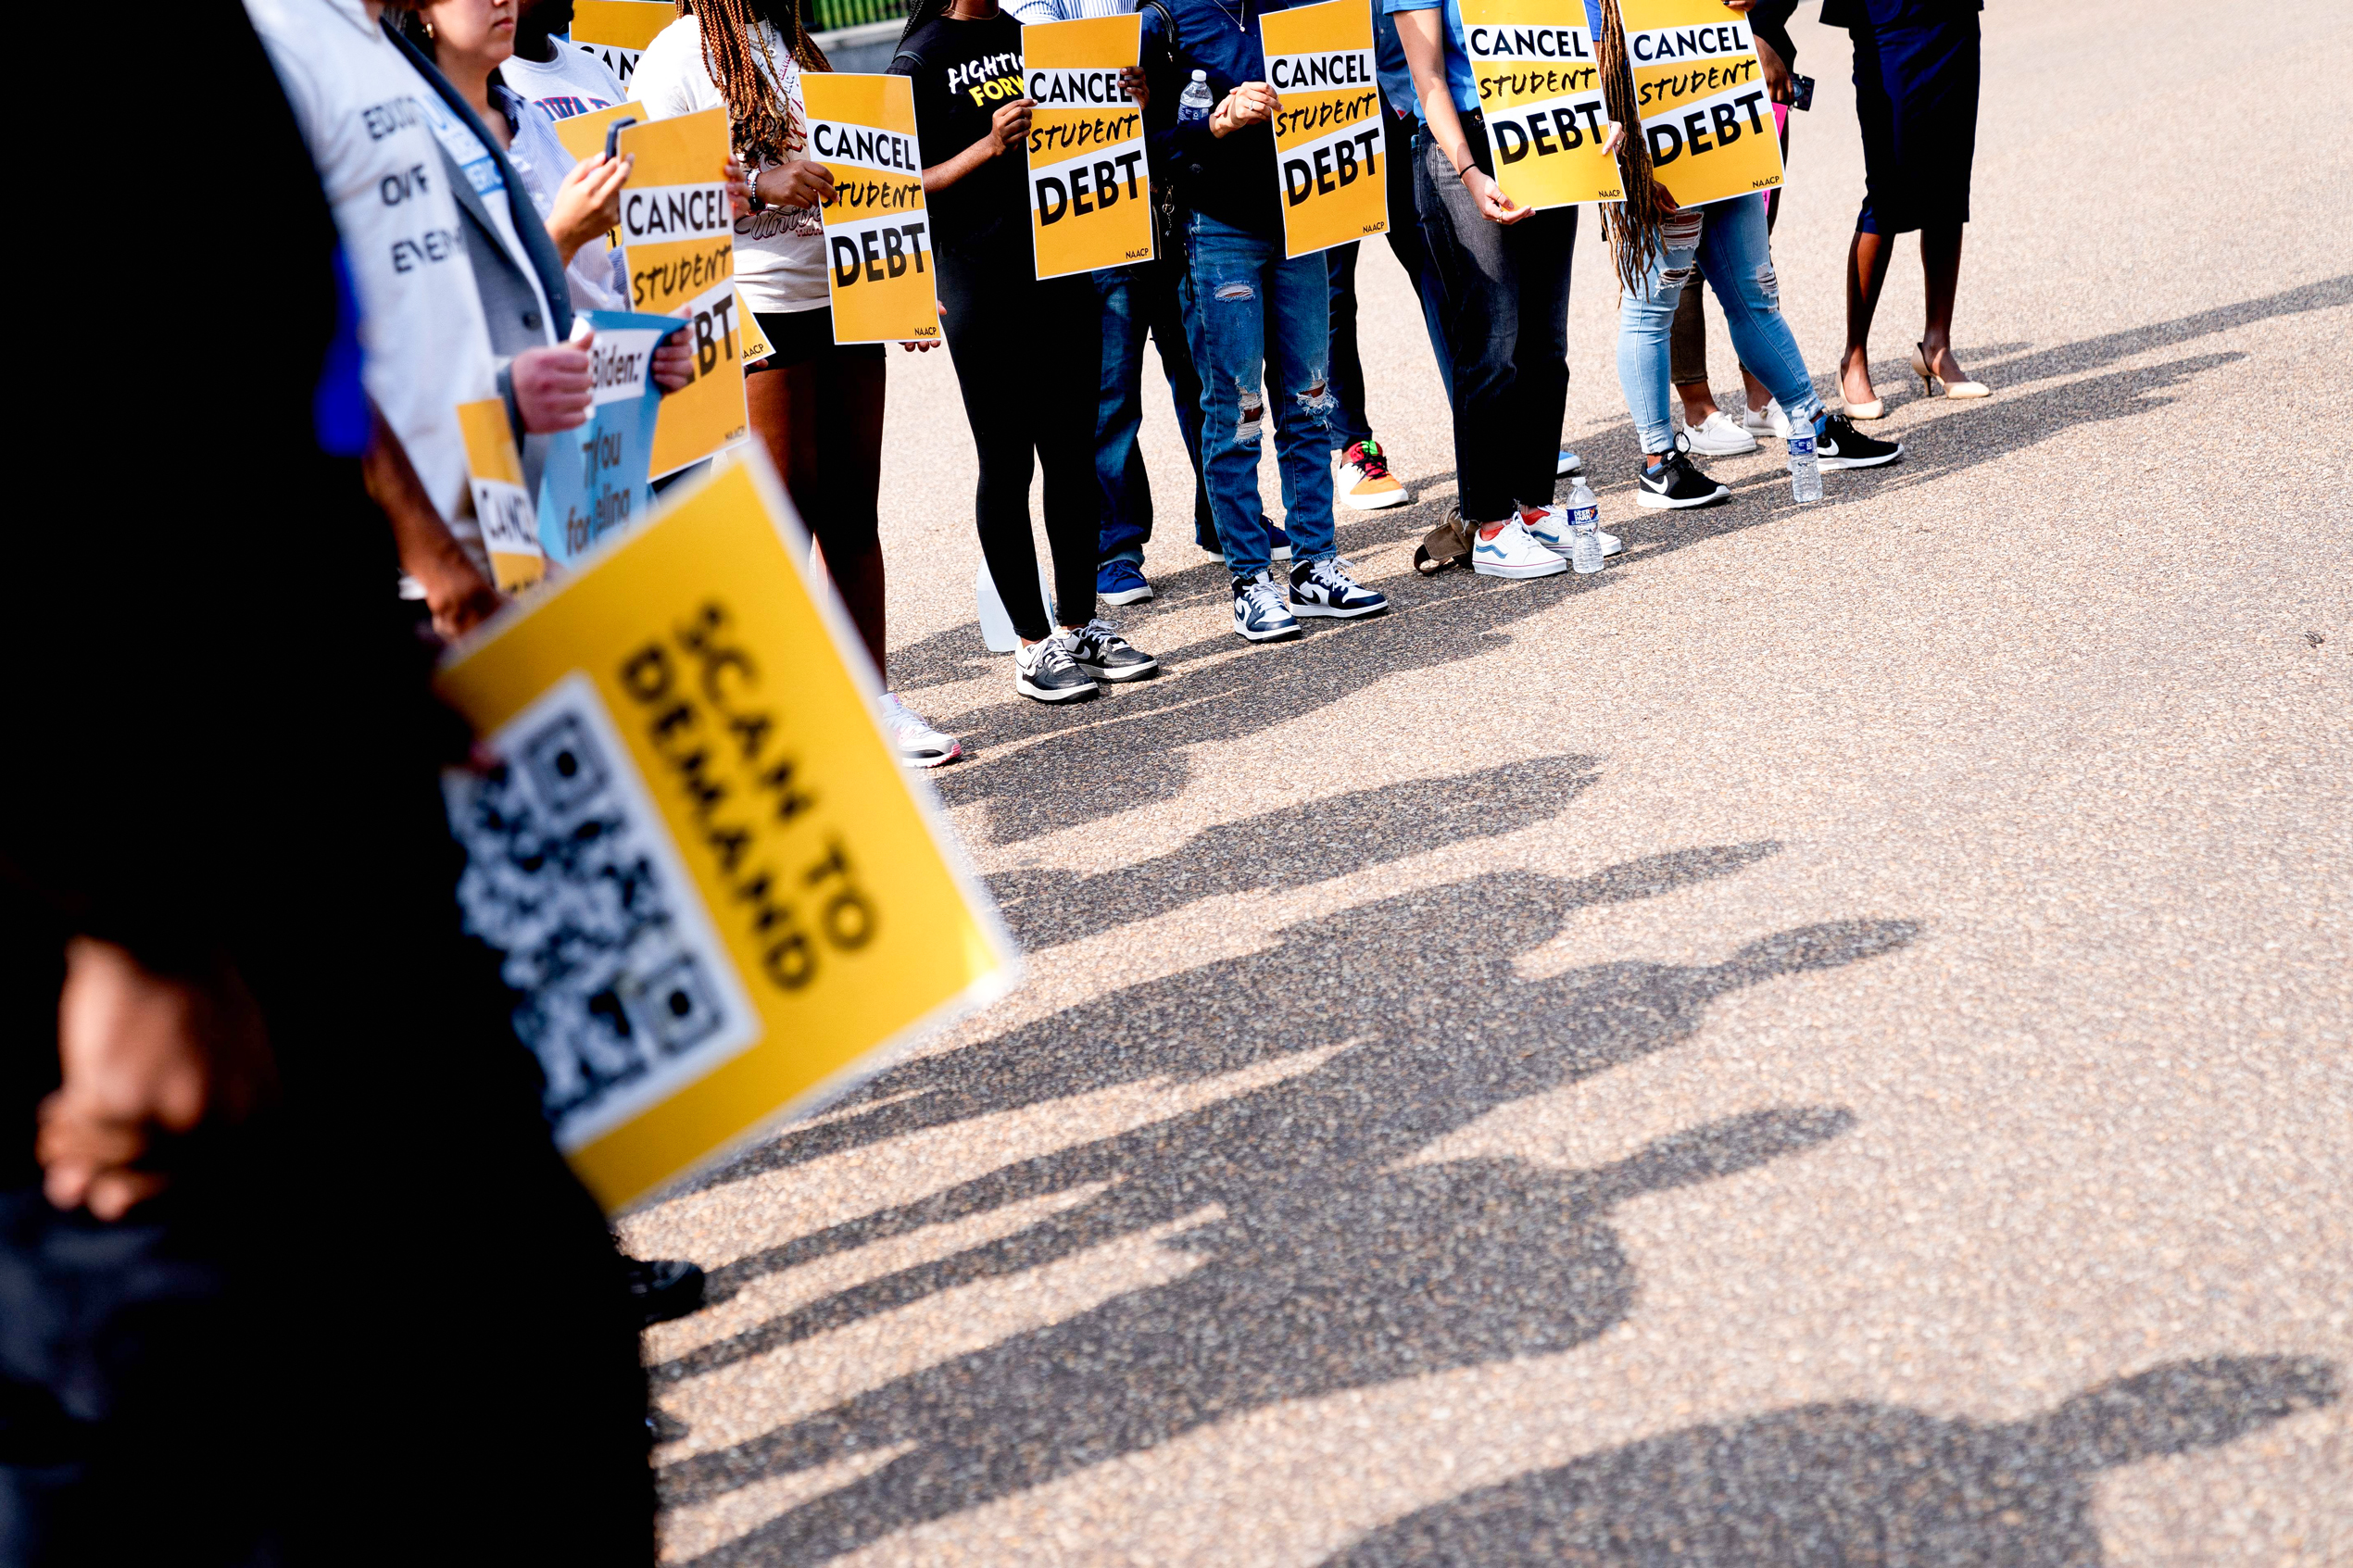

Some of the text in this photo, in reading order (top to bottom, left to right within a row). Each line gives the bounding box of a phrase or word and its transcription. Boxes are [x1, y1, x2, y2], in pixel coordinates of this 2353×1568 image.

[1471, 29, 1589, 57] CANCEL
[1634, 27, 1748, 61] CANCEL
[1029, 71, 1133, 104] CANCEL
[1272, 55, 1371, 89] CANCEL
[1479, 68, 1597, 101] STUDENT
[1639, 60, 1757, 107] STUDENT
[1028, 113, 1140, 155] STUDENT
[1275, 92, 1377, 138] STUDENT
[1492, 100, 1603, 166] DEBT
[1646, 90, 1764, 169] DEBT
[814, 124, 916, 171] CANCEL
[1284, 128, 1380, 207] DEBT
[1036, 150, 1142, 227] DEBT
[1598, 190, 1621, 198] NAACP
[1752, 176, 1780, 188] NAACP
[626, 190, 728, 236] CANCEL
[1363, 221, 1385, 234] NAACP
[634, 245, 732, 307] STUDENT
[830, 221, 925, 288] DEBT
[1126, 247, 1150, 259] NAACP
[914, 326, 937, 337] NAACP
[674, 603, 880, 955] SCAN TO
[620, 642, 820, 993] DEMAND
